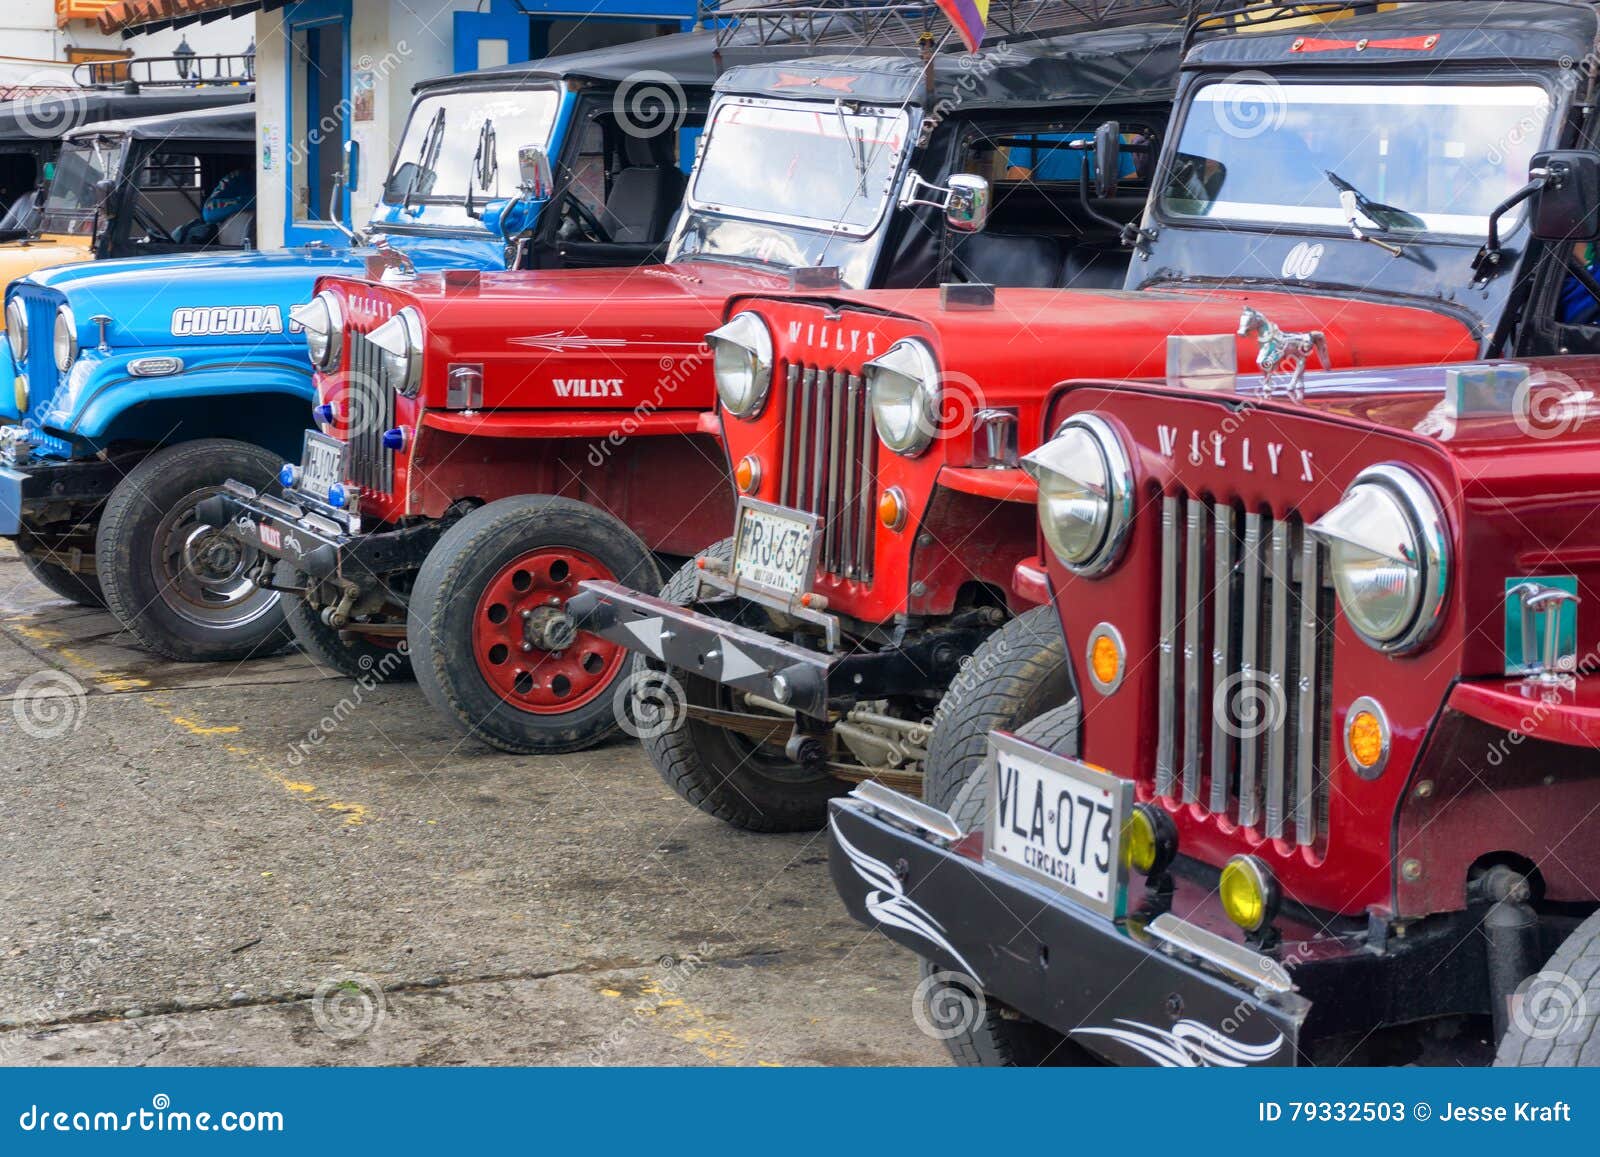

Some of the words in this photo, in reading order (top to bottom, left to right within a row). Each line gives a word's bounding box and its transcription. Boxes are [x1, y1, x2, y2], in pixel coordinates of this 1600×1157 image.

[171, 305, 283, 336] COCORA
[789, 321, 875, 355] WILLYS
[552, 379, 624, 397] WILLYS
[1157, 424, 1313, 482] WILLYS
[997, 762, 1045, 847] VLA
[1056, 790, 1113, 874] 073
[1024, 846, 1076, 886] CIRCASIA
